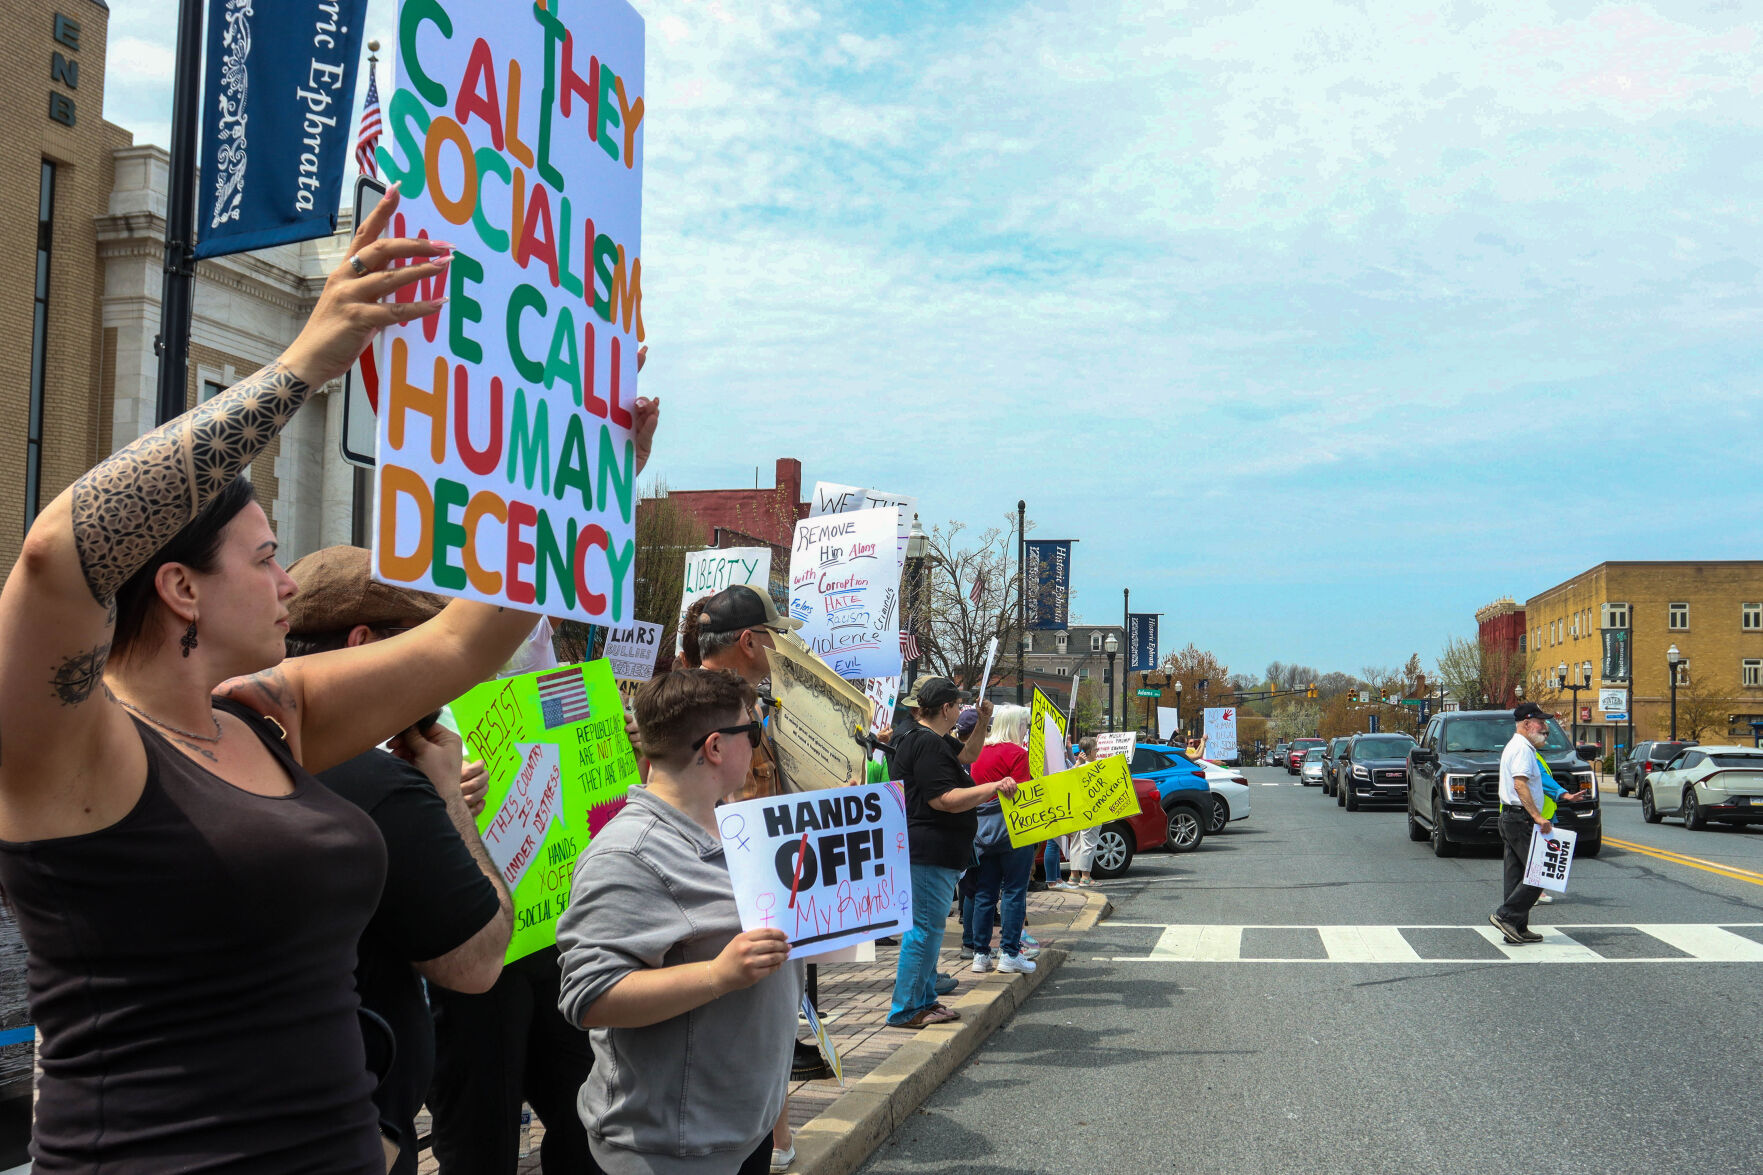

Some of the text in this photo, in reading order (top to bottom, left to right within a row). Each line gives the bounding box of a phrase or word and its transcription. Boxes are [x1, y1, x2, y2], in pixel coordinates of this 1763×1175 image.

[399, 0, 564, 193] CALL
[533, 1, 644, 169] THEY
[295, 0, 347, 212] ric Ephrata
[375, 88, 645, 342] SOCIALISM
[394, 212, 633, 430] WE CALL
[388, 337, 634, 525] HUMAN
[379, 463, 634, 623] DECENCY
[797, 522, 857, 552] REMOVE
[820, 542, 876, 561] Him Along
[686, 558, 758, 593] LIBERTY
[793, 567, 816, 585] with
[1053, 545, 1066, 623] Historic Ephrata
[790, 598, 814, 614] Felons
[824, 595, 862, 613] HATE
[826, 611, 870, 627] Racism
[606, 643, 652, 660] BULLIES
[611, 627, 655, 646] LIARS
[834, 656, 861, 672] EVIL
[466, 679, 523, 767] RESIST
[579, 745, 596, 767] ARE
[596, 737, 613, 760] NOT
[578, 767, 602, 794] THEY
[604, 761, 617, 787] ARE
[1082, 760, 1106, 788] SAVE
[1088, 777, 1108, 799] OUR
[486, 743, 544, 844] THIS COUNTRY
[1012, 784, 1044, 806] DUE
[504, 765, 560, 884] UNDER DISTRESS
[519, 798, 535, 827] IS
[763, 792, 882, 838] HANDS
[1009, 792, 1072, 831] PROCESS!
[548, 837, 577, 868] HANDS
[775, 828, 885, 892] OFF!
[1541, 839, 1561, 879] OFF!
[1556, 841, 1571, 880] HANDS
[517, 897, 554, 932] SOCIAL
[796, 866, 896, 938] My Rights!
